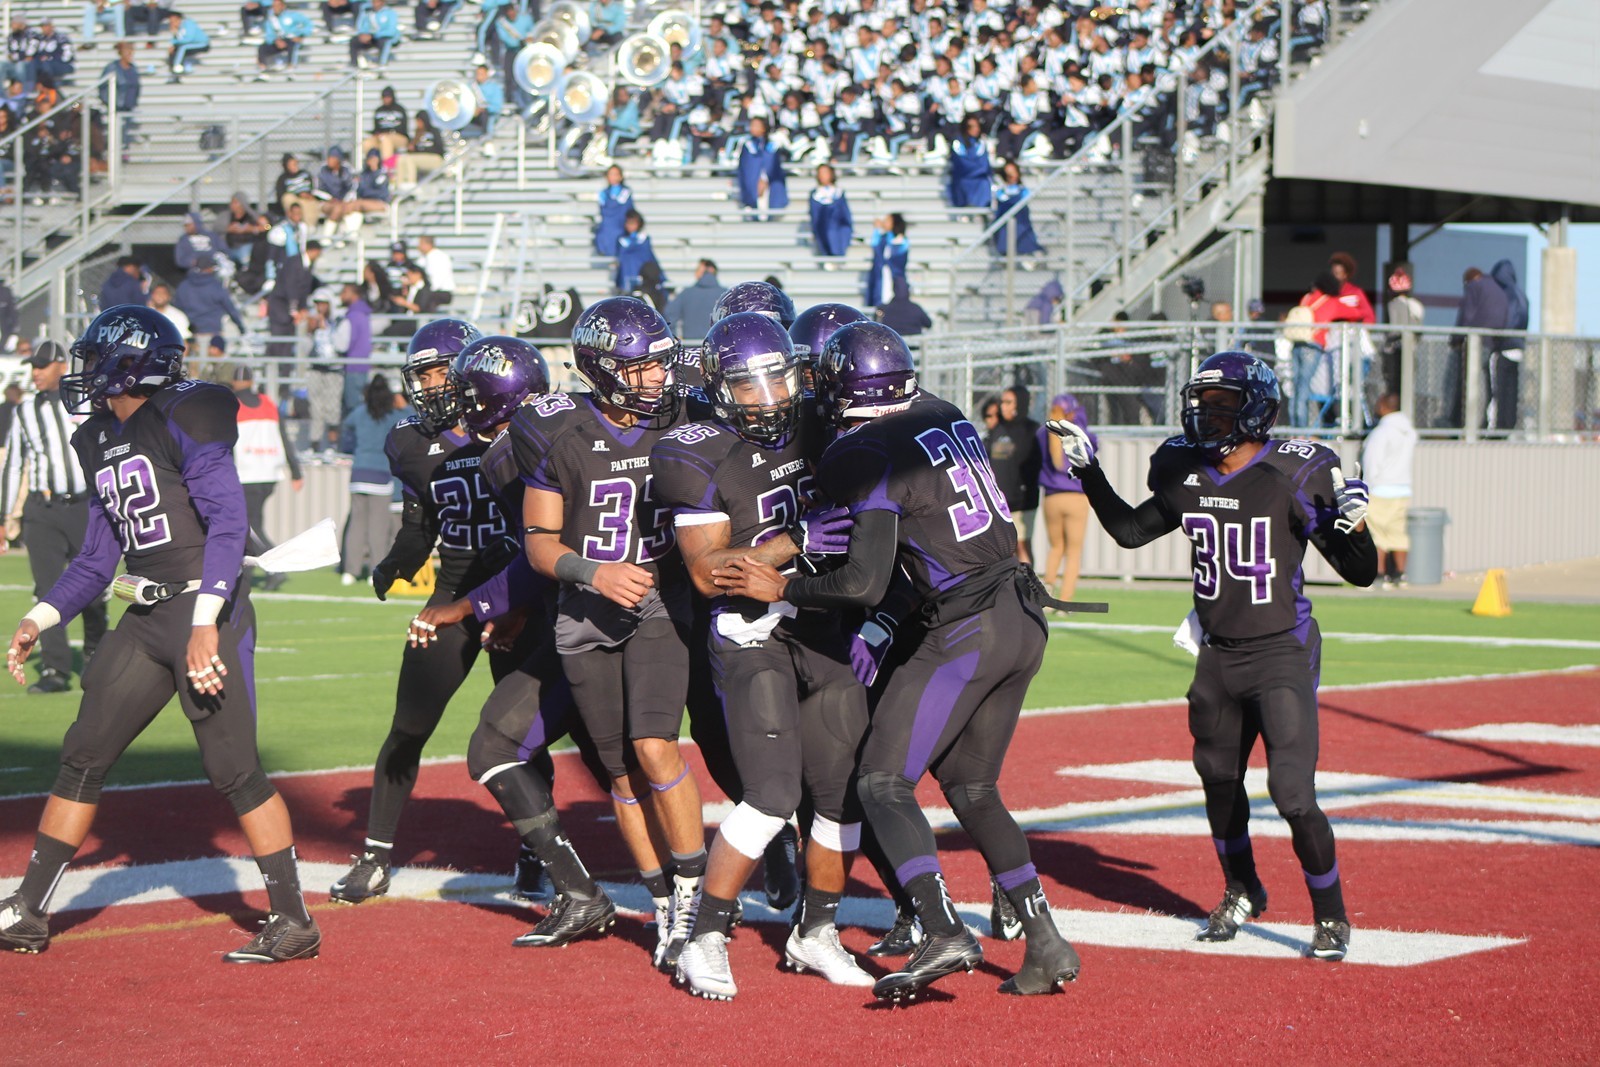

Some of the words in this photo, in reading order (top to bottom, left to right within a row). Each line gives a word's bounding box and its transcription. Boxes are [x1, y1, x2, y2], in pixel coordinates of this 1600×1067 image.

[574, 326, 618, 352] PVAMU
[1246, 364, 1278, 385] PVA
[894, 388, 905, 399] 30
[445, 456, 481, 471] PANTHER
[610, 456, 650, 472] PANTHE
[769, 458, 805, 481] PANTHERS
[914, 420, 1014, 542] 30
[95, 454, 172, 552] 32
[1199, 496, 1240, 511] PANTHERS
[1182, 512, 1276, 604] 34
